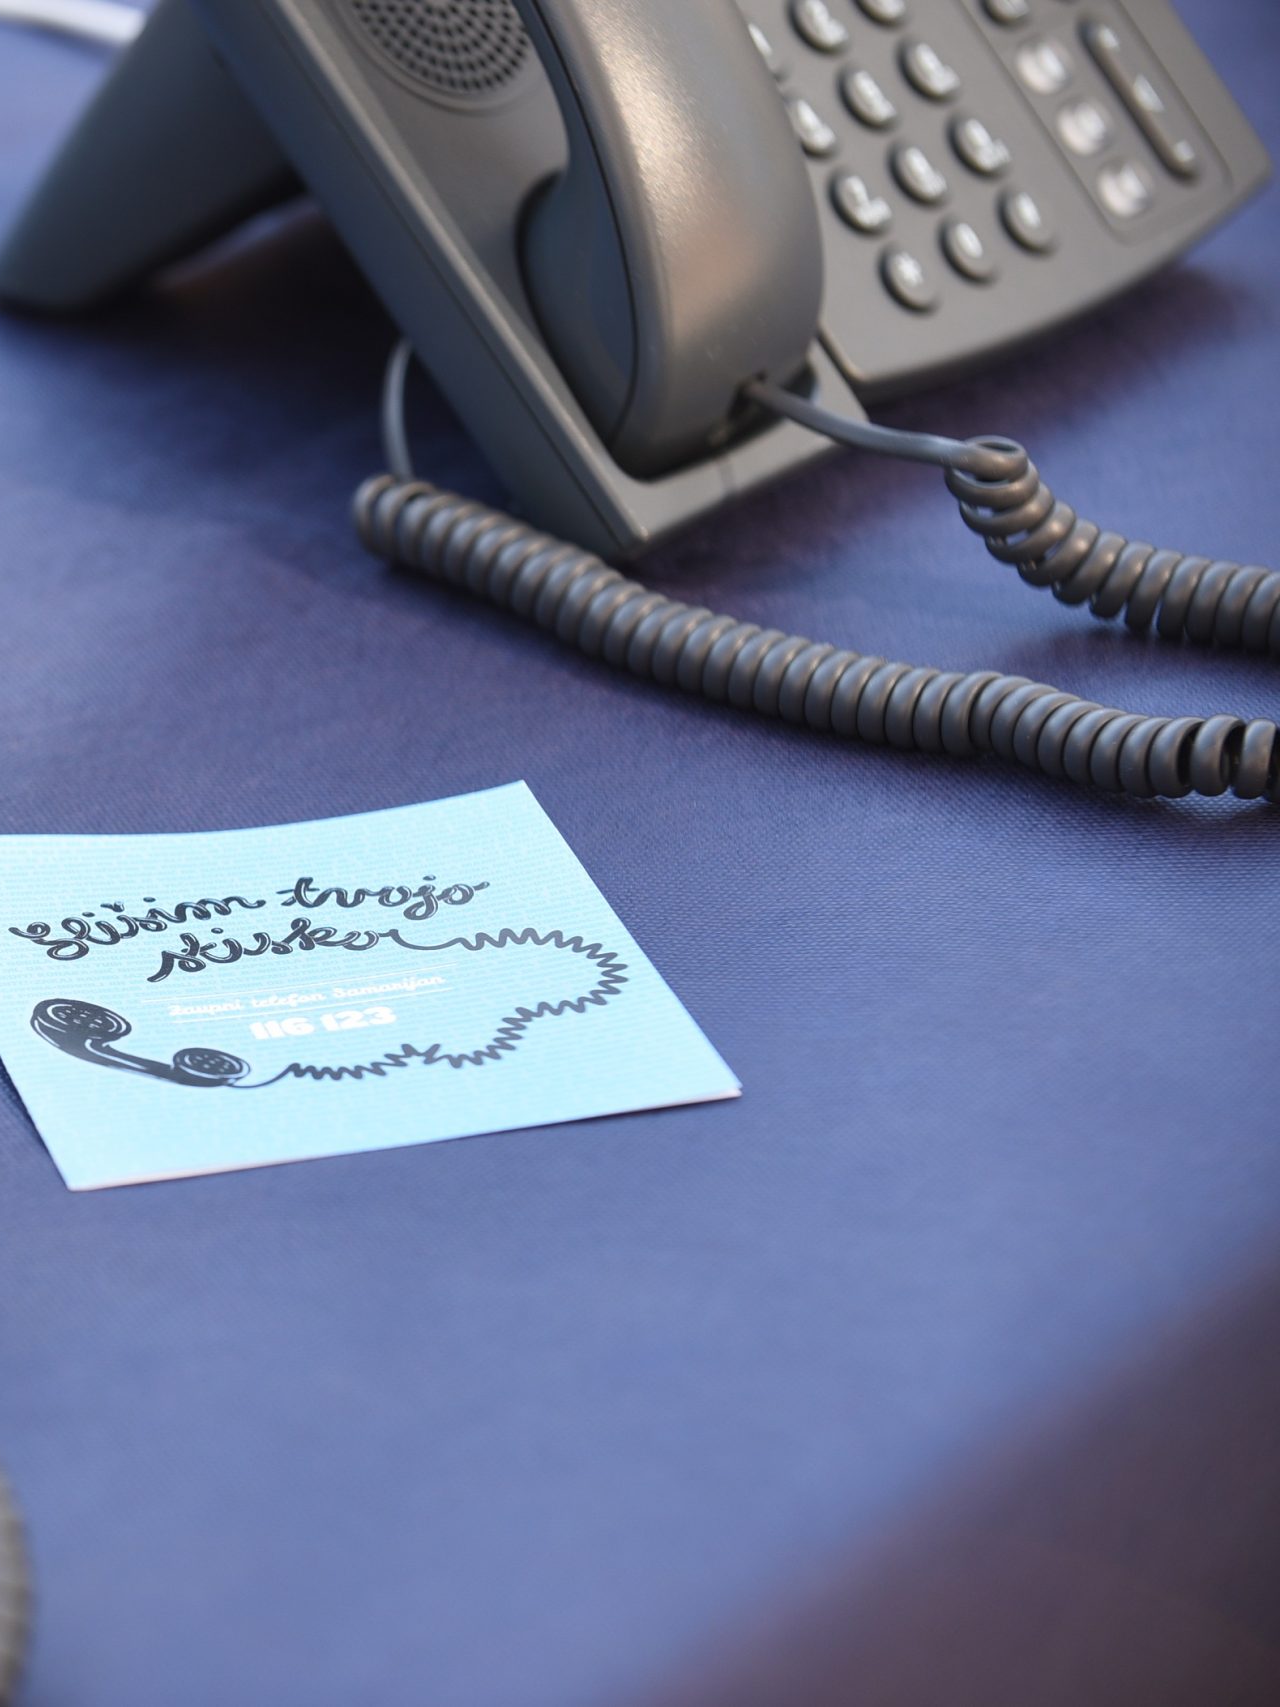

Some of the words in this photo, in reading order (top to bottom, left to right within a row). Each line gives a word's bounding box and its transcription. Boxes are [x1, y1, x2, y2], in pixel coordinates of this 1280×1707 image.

[276, 874, 490, 921] tvojo
[146, 916, 399, 983] stisko
[251, 991, 328, 1008] telefon
[333, 974, 447, 998] Samarijan
[249, 1016, 316, 1041] 116
[320, 1006, 398, 1032] 123
